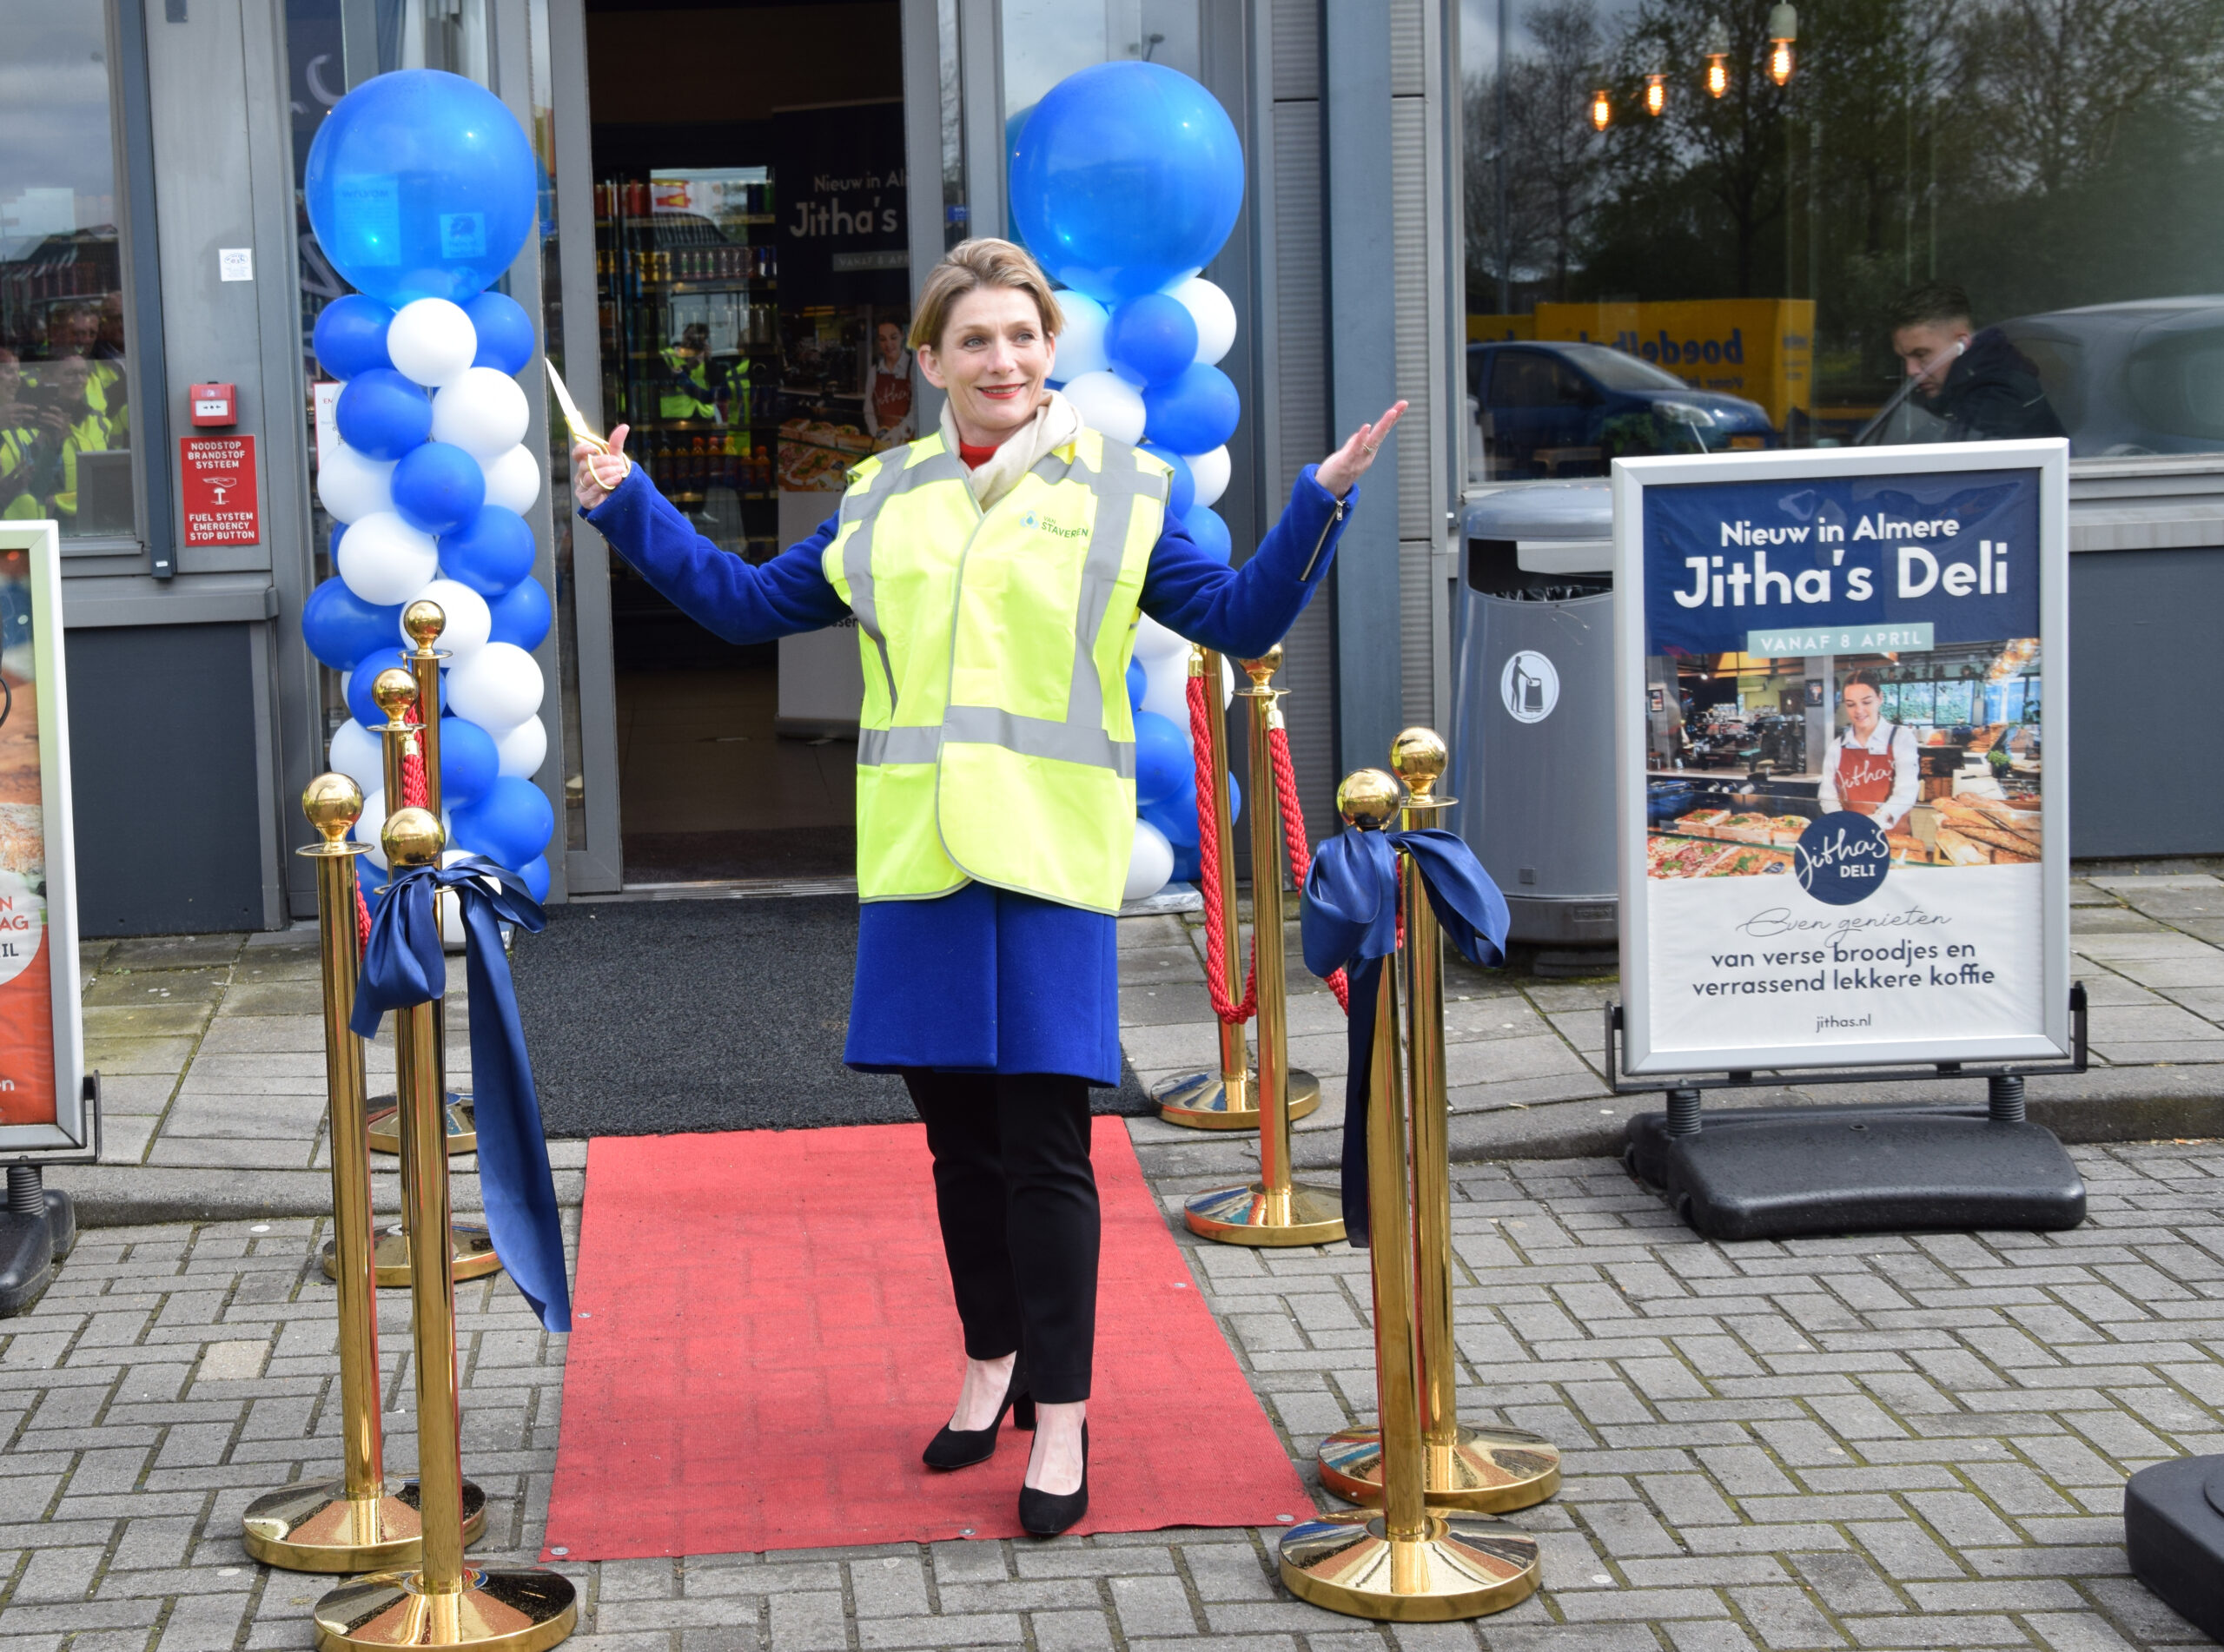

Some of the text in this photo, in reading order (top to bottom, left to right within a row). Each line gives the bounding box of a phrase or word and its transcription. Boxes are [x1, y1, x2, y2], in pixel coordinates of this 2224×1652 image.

[814, 168, 907, 192] Nieuw in Al
[790, 196, 897, 238] Jitha's
[188, 450, 246, 460] BRANDSTOF
[190, 441, 242, 451] NOODSTOP
[195, 460, 240, 470] SYSTEEM
[189, 512, 254, 522] FUEL SYSTEM
[1043, 515, 1056, 525] VAN
[189, 531, 255, 541] STOP BUTTON
[193, 522, 250, 532] EMERGENCY
[1041, 521, 1089, 539] STAVEREN
[1721, 512, 1960, 547] Nieuw in Almere
[1673, 540, 2008, 608] Jitha's Deli
[1761, 631, 1922, 652] VANAF 8 APRIL
[1840, 864, 1876, 878] DELI
[1736, 906, 1952, 948] Even genieten
[0, 942, 19, 957] IL
[1711, 939, 1976, 968] van verse broodjes en
[1692, 963, 1995, 996] verrassend lekkere koffie
[1816, 1014, 1872, 1034] jithas.nl
